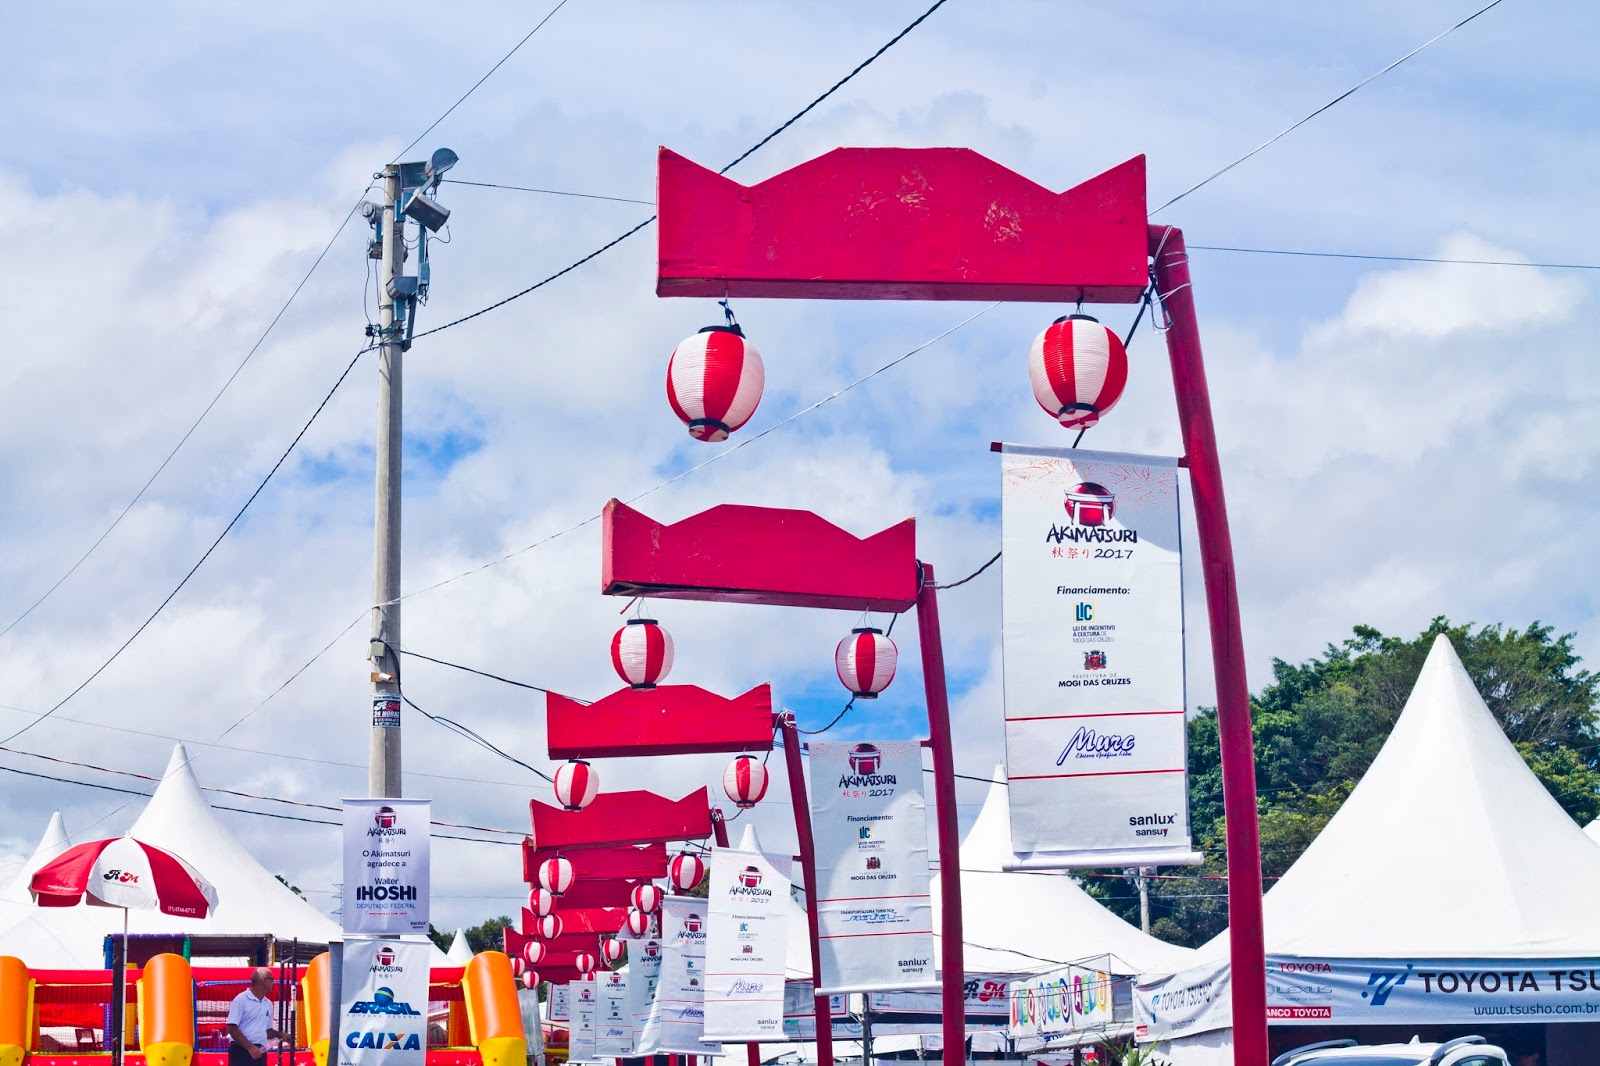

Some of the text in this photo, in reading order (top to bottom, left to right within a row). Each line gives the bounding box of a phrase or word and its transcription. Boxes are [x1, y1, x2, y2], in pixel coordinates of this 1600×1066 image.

[1046, 523, 1138, 544] AKIMATSURI
[1051, 547, 1133, 559] 秋祭り 2017
[1056, 586, 1130, 595] Financiamento:
[1075, 602, 1093, 621] LIC
[839, 774, 897, 788] AKIMATSURI
[869, 788, 894, 797] 2017
[1129, 813, 1175, 826] sanlux
[367, 827, 406, 837] AKIMATSURI
[1135, 828, 1168, 836] sansuy
[357, 886, 417, 900] IHOSHI
[729, 886, 772, 896] AKIMATSURI
[898, 958, 927, 966] sanlux
[1278, 963, 1331, 972] TOYOTA
[1418, 971, 1540, 993] TOYOTA
[1161, 989, 1185, 1011] TOYOTA
[348, 1001, 421, 1015] BRASIL
[1267, 1008, 1330, 1017] ANCO TOYOTA
[1473, 1002, 1599, 1016] www.tsusho.com.br
[346, 1031, 420, 1050] CAIXA
